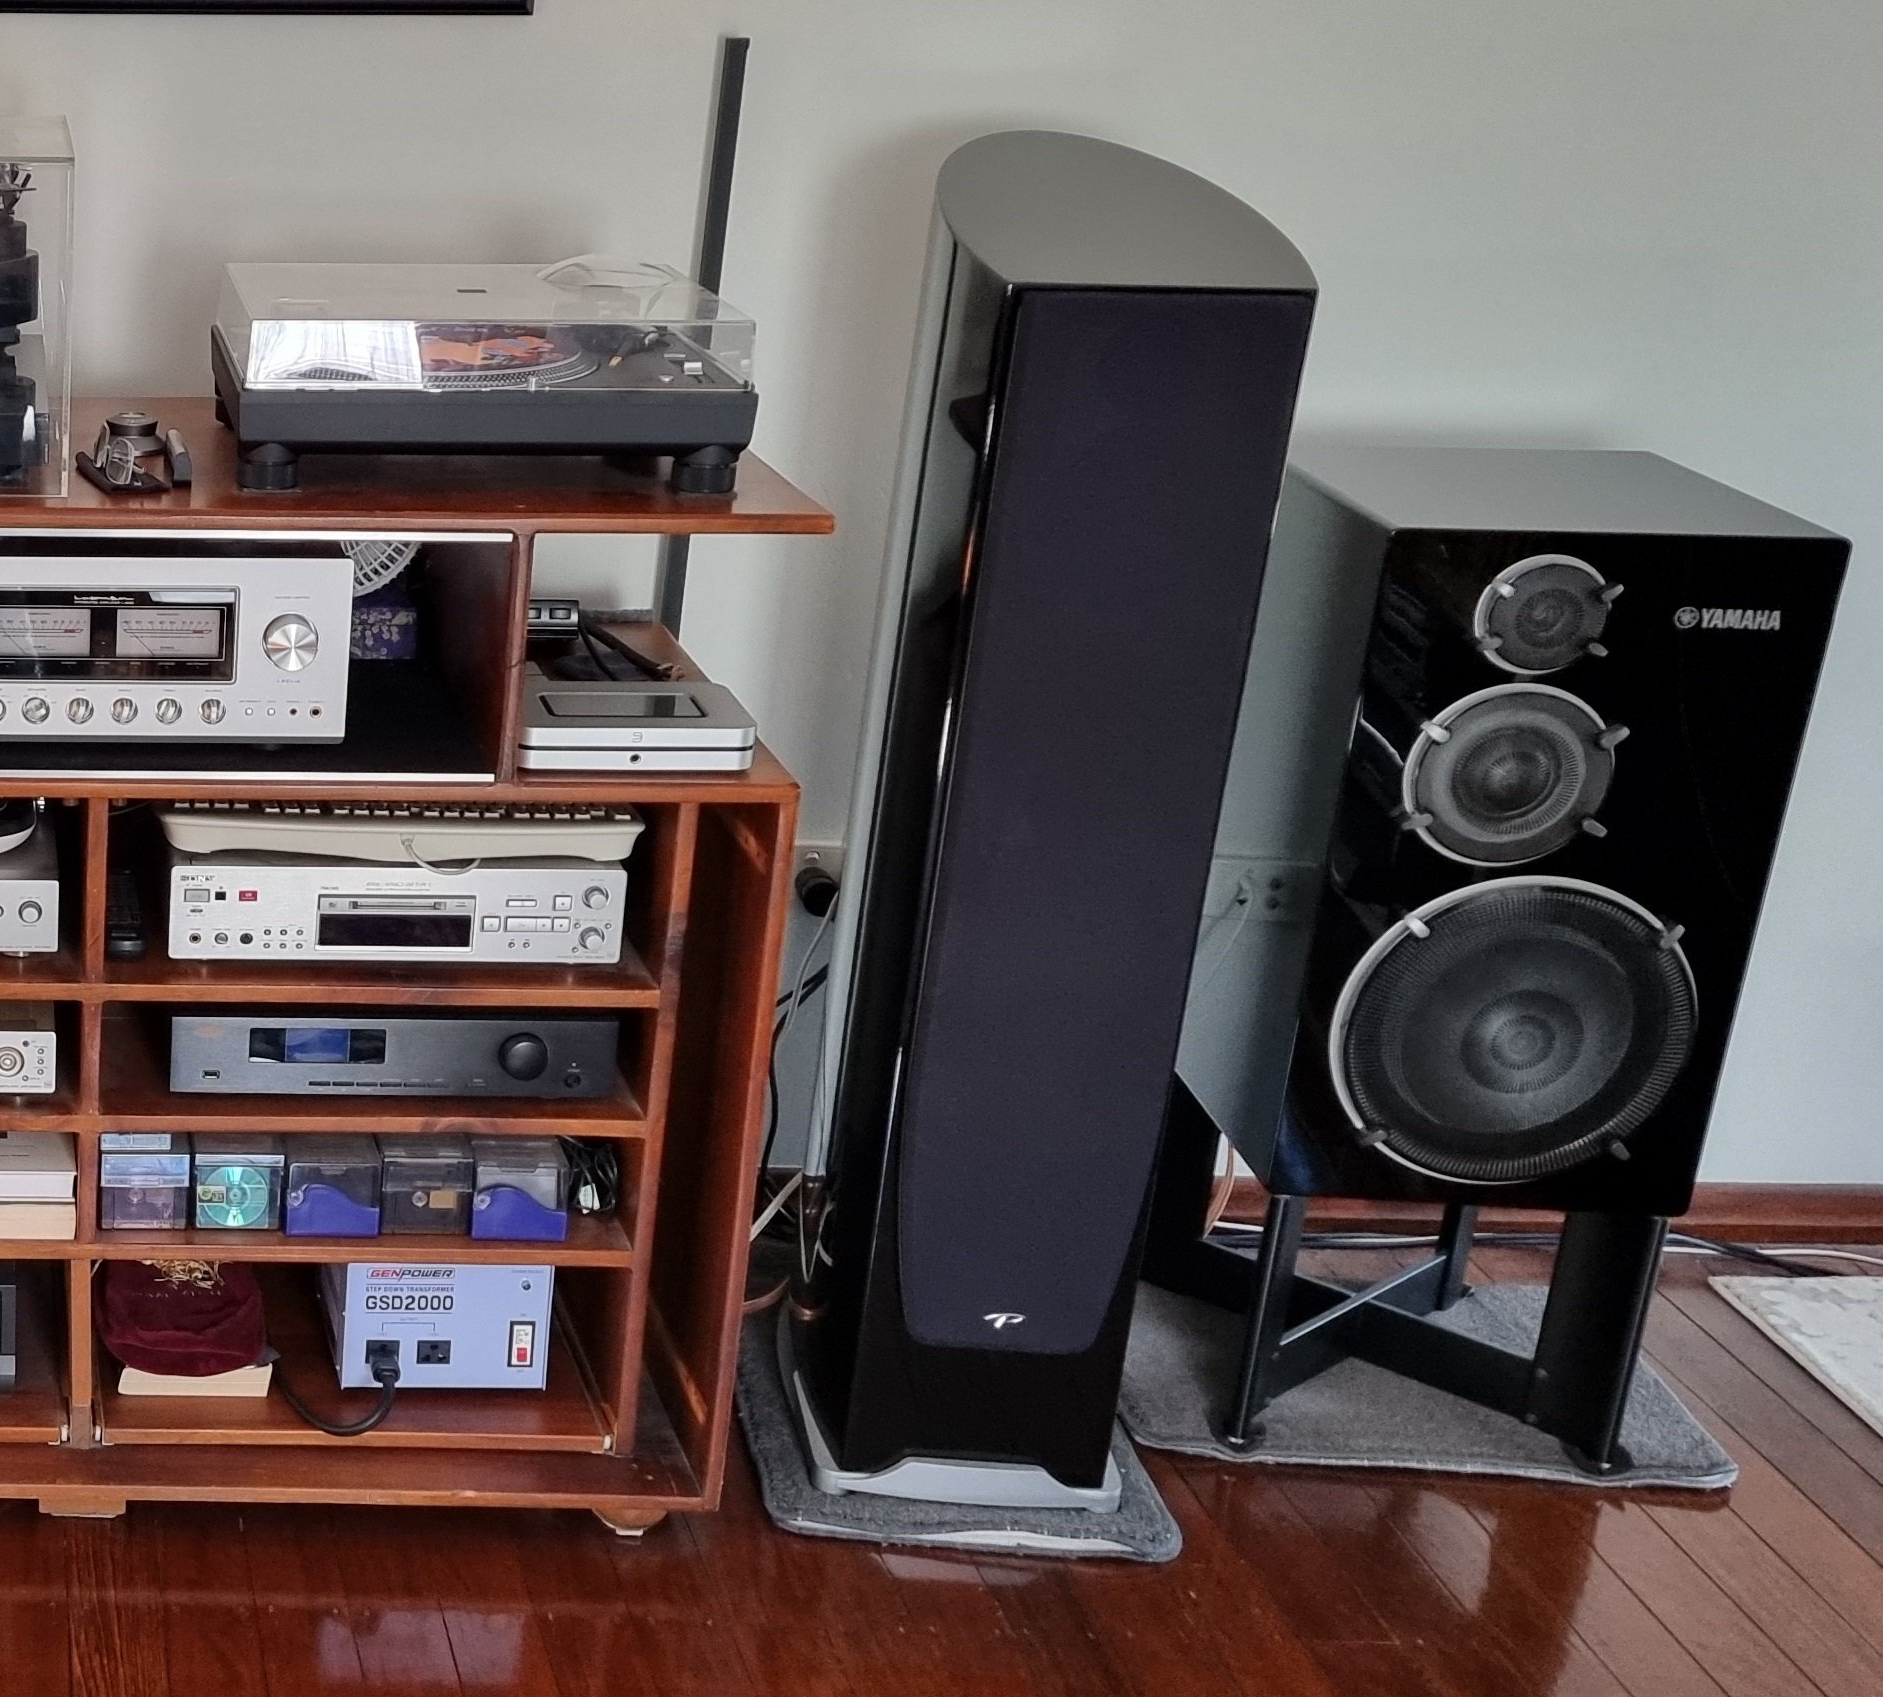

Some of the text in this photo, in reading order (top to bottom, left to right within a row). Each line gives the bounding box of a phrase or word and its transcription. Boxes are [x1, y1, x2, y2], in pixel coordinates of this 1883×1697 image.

[1700, 607, 1781, 630] YAMAHA
[369, 1267, 454, 1281] GENPOWER
[365, 1295, 454, 1311] GSD2000
